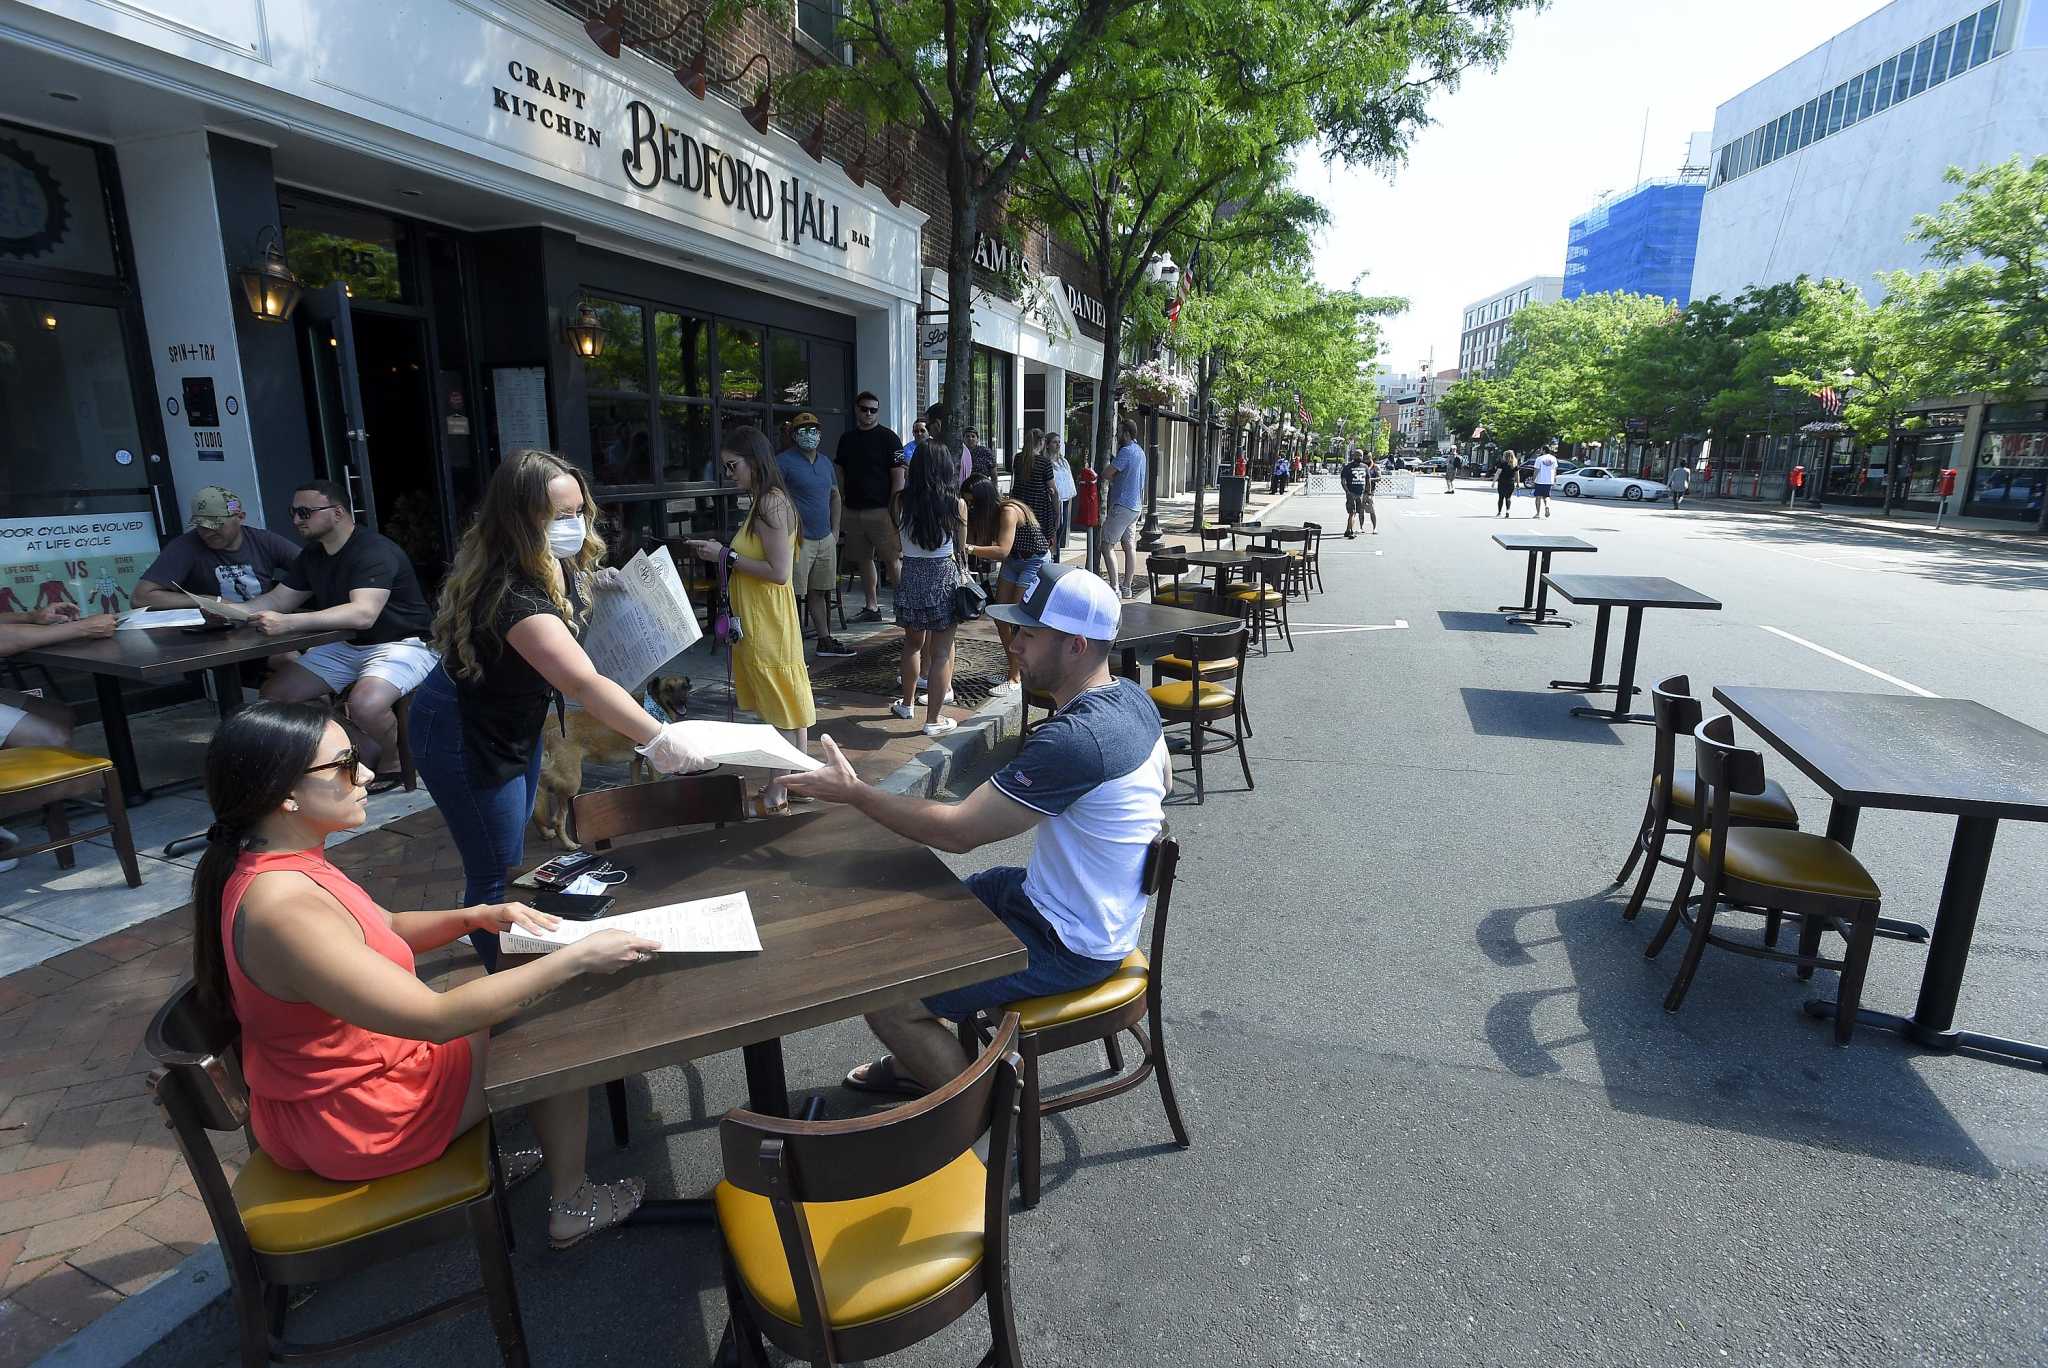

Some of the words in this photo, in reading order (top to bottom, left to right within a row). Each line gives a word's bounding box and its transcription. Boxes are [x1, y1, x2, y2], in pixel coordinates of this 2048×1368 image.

[508, 60, 586, 110] CRAFT
[492, 86, 601, 148] KITCHEN
[621, 100, 774, 220] BEDFORD
[780, 176, 848, 252] HALL
[851, 229, 870, 249] BAR
[970, 231, 1030, 277] AMES
[194, 432, 223, 449] STUDIO
[1351, 470, 1367, 481] 32
[37, 524, 89, 536] CYCLING
[93, 521, 144, 533] EVOLVED
[27, 540, 42, 551] AT
[46, 538, 71, 550] LIFE
[74, 536, 112, 548] CYCLE
[64, 560, 89, 579] VS
